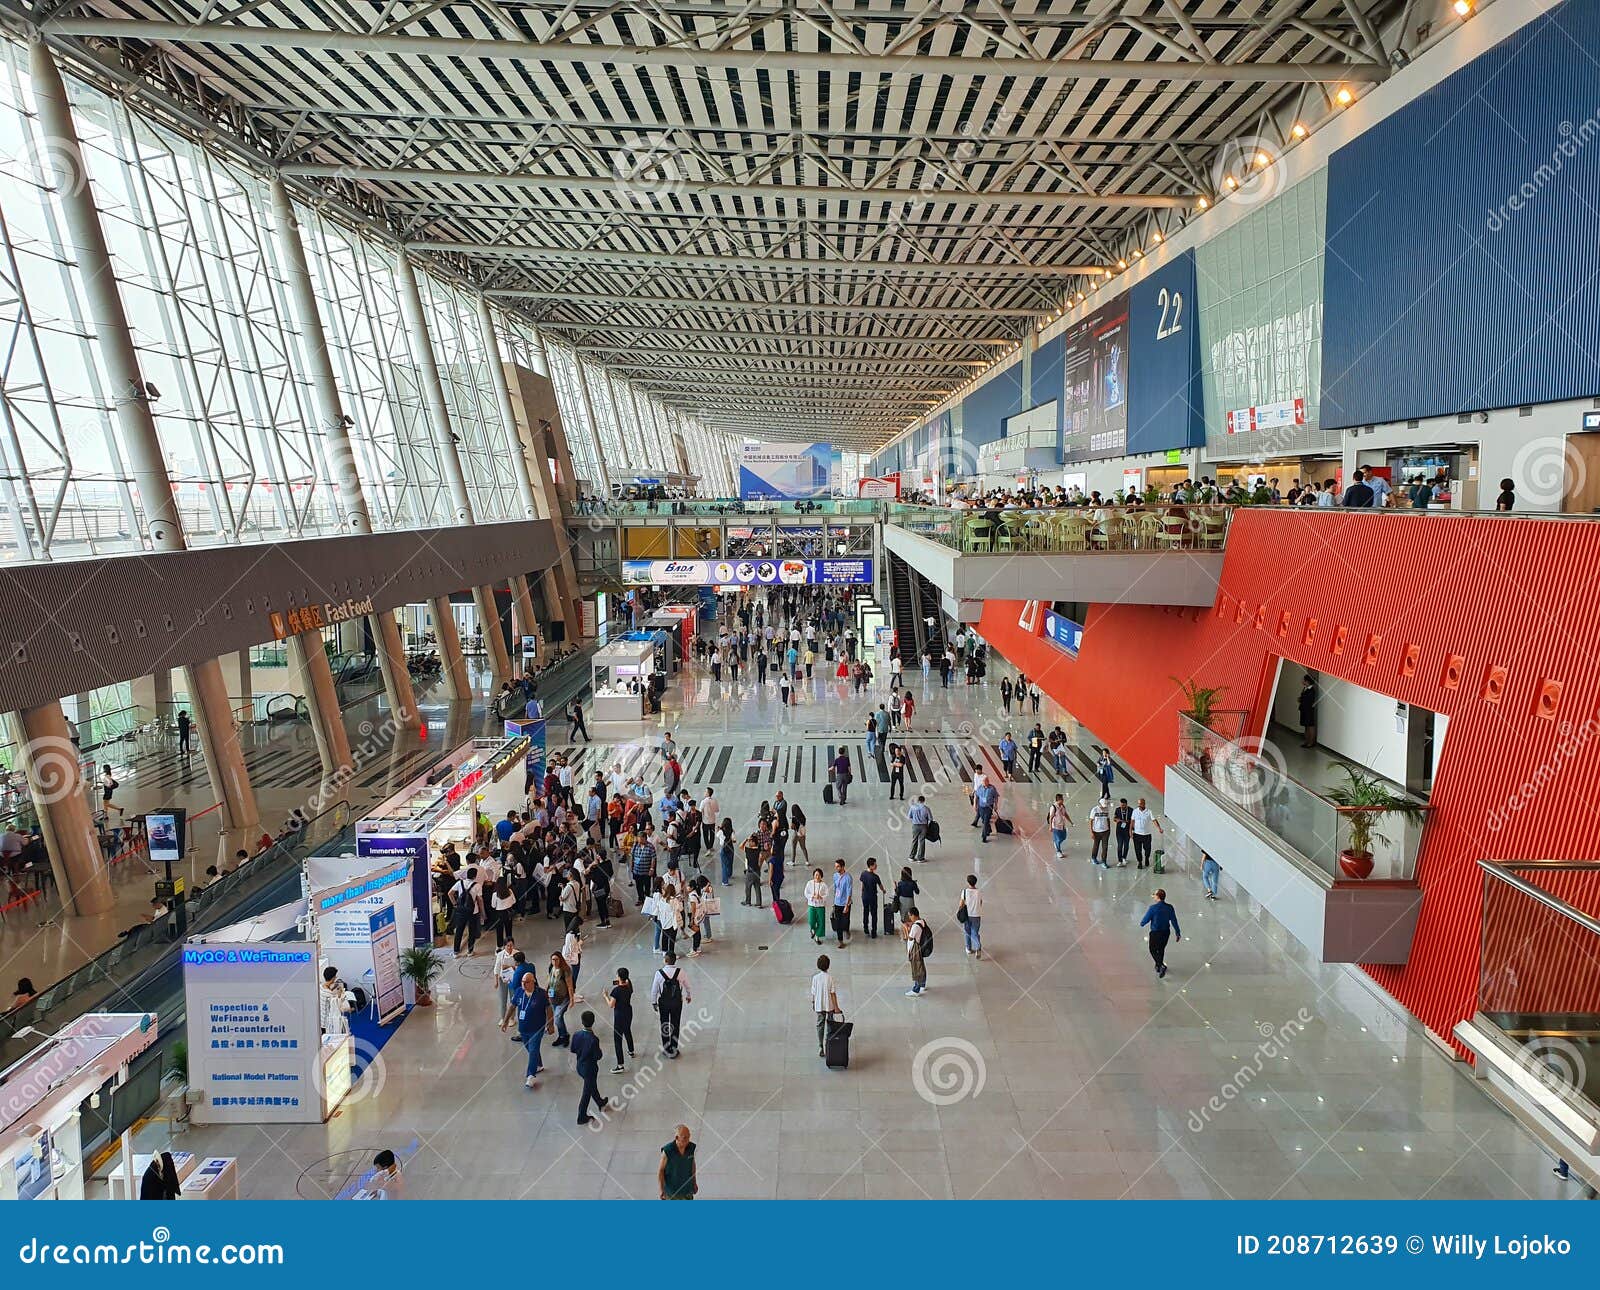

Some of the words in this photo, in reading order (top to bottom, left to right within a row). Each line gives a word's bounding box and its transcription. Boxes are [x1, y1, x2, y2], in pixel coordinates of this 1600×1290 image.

[664, 562, 695, 572] BADA
[324, 603, 350, 622] Fast
[347, 595, 374, 617] Food
[321, 893, 345, 909] more
[345, 886, 365, 898] than
[366, 868, 409, 890] inspection
[184, 950, 225, 964] MyQC
[227, 950, 237, 962] &
[240, 950, 311, 963] WeFinance
[210, 1004, 258, 1013] Inspection
[211, 1014, 260, 1022] WeFinance
[263, 1014, 270, 1022] &
[211, 1025, 286, 1033] Anti-counterfeit
[212, 1073, 241, 1081] National
[243, 1073, 265, 1081] Model
[267, 1073, 299, 1081] Platform
